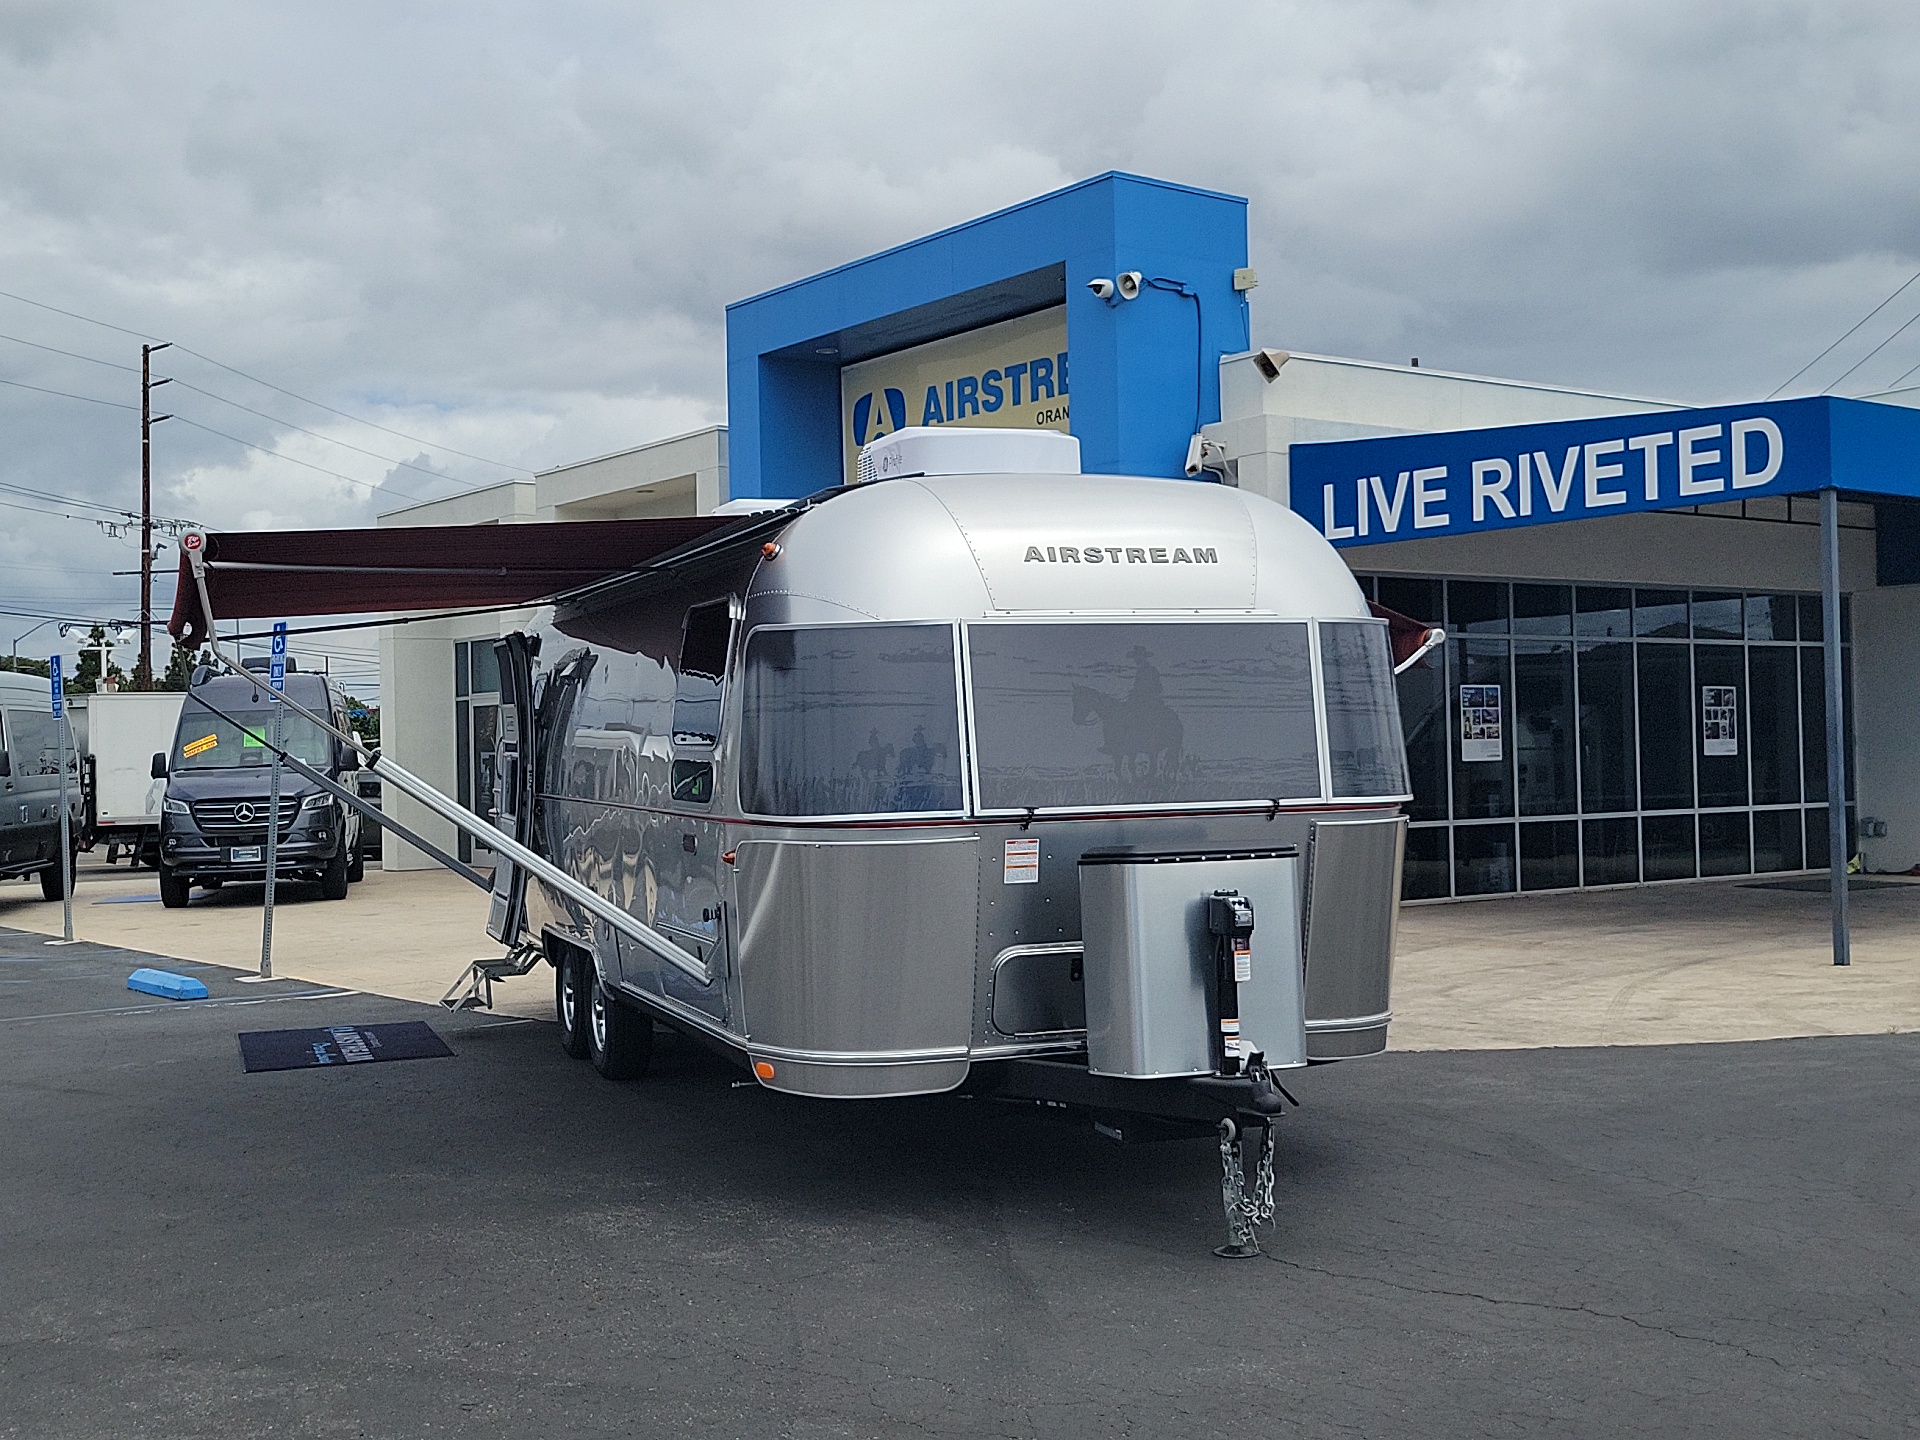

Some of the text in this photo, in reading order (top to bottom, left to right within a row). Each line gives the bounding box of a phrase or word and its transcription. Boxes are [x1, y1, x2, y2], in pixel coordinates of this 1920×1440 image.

[1323, 417, 1785, 541] LIVE RIVETED
[1024, 546, 1218, 564] AIRSTREAM
